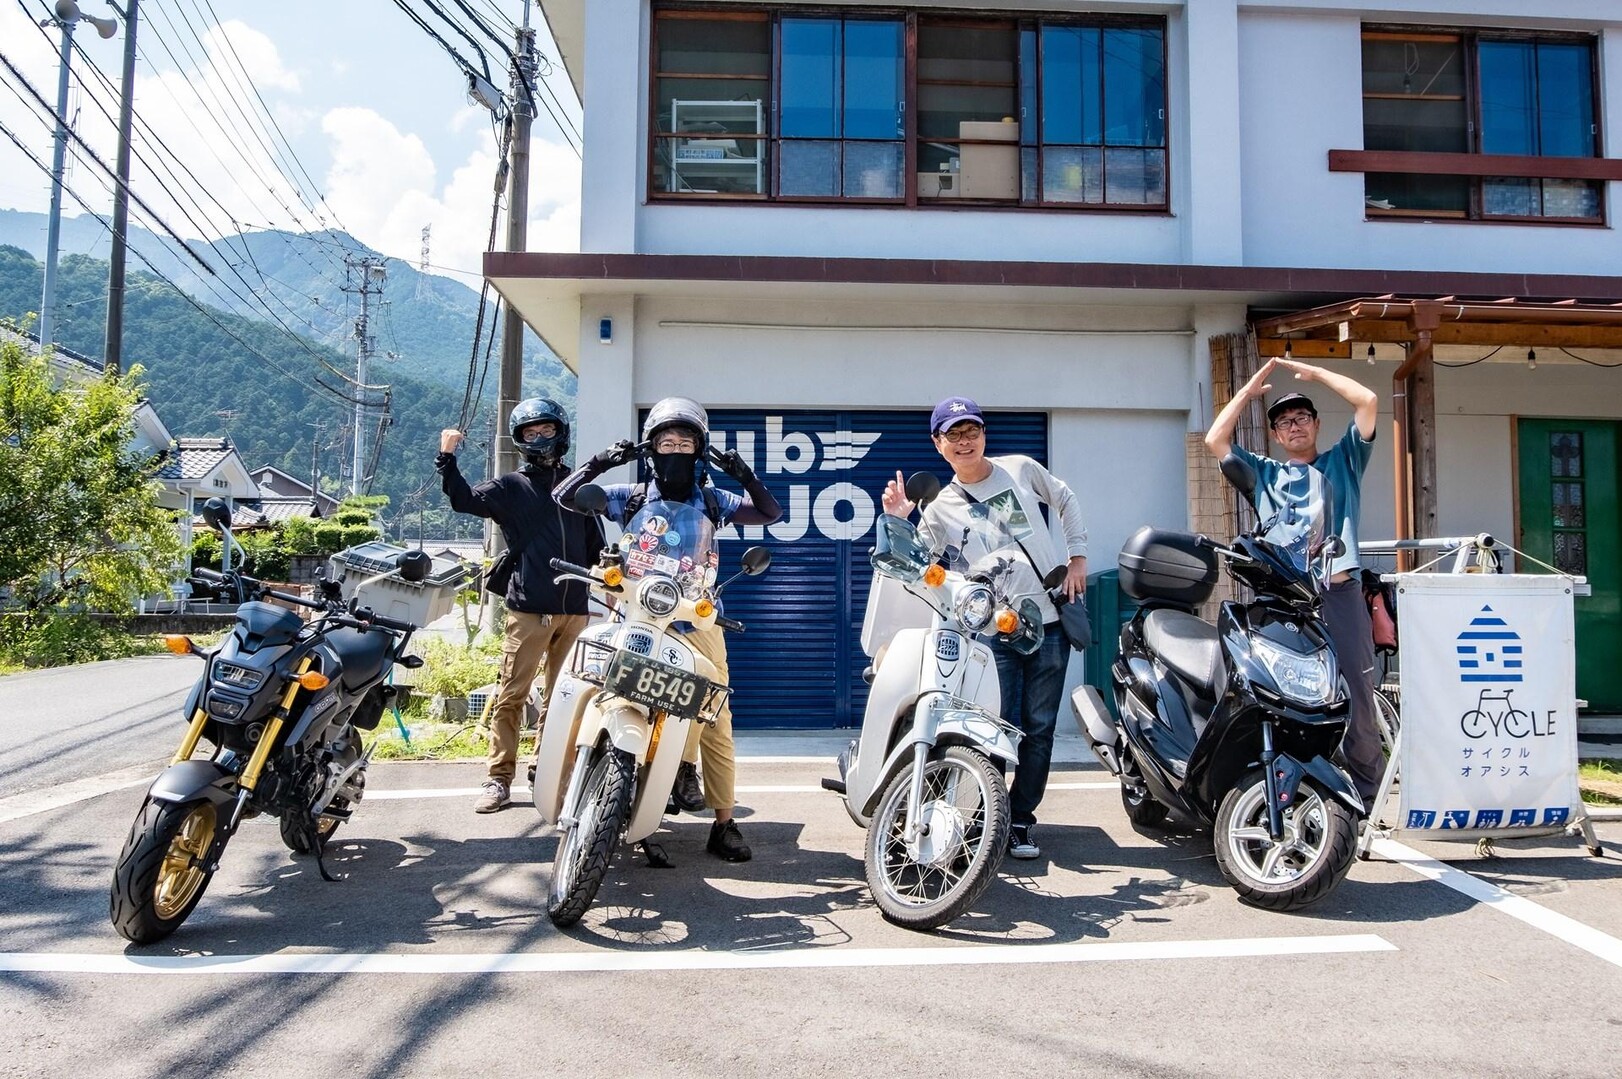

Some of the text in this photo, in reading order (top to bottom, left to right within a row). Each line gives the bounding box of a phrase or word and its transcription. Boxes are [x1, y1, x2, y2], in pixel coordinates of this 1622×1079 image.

[709, 416, 815, 474] ub
[631, 625, 653, 634] HONDA
[615, 664, 695, 706] F 8549
[630, 691, 675, 710] FARM USE
[1461, 710, 1556, 738] CYCLE
[1463, 747, 1530, 759] サイクル
[1461, 765, 1529, 777] オアシス
